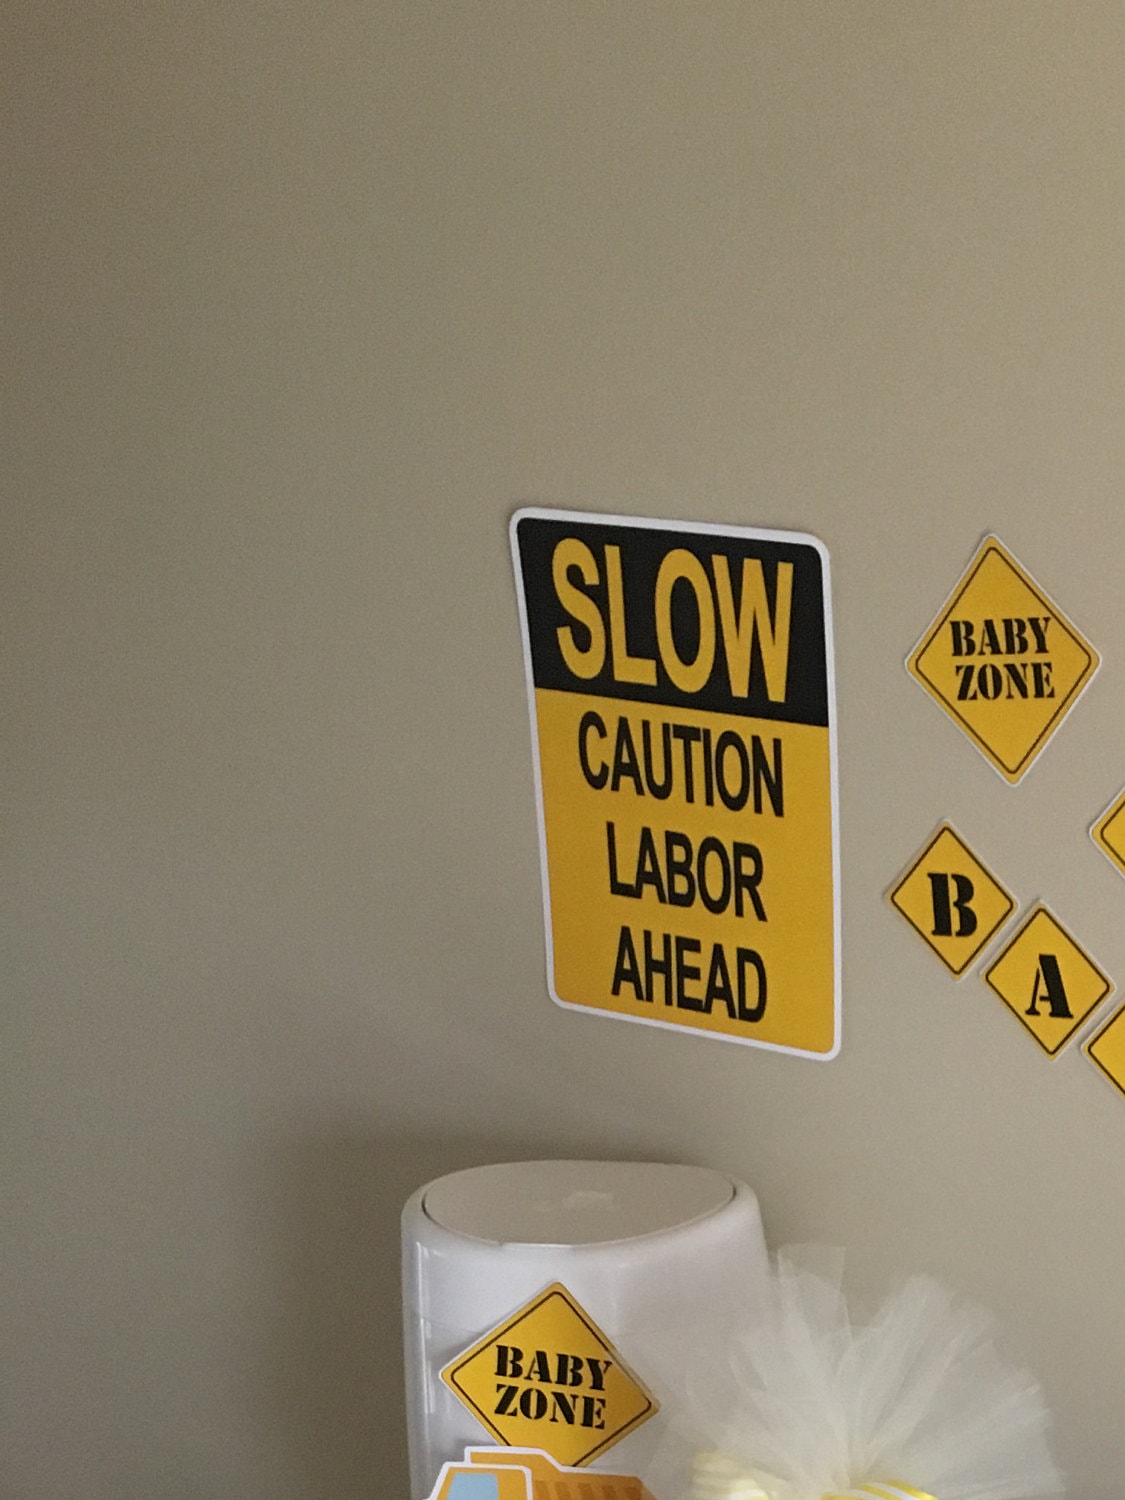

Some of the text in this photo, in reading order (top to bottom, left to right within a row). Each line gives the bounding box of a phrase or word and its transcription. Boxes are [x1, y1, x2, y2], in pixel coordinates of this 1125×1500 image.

[552, 538, 794, 704] SLOW
[950, 617, 1051, 657] BABY
[955, 663, 1055, 701] ZONE
[578, 711, 785, 818] CAUTION
[606, 822, 767, 922] LABOR
[611, 926, 768, 1024] AHEAD
[494, 1344, 612, 1391] BABY
[494, 1384, 606, 1429] ZONE
